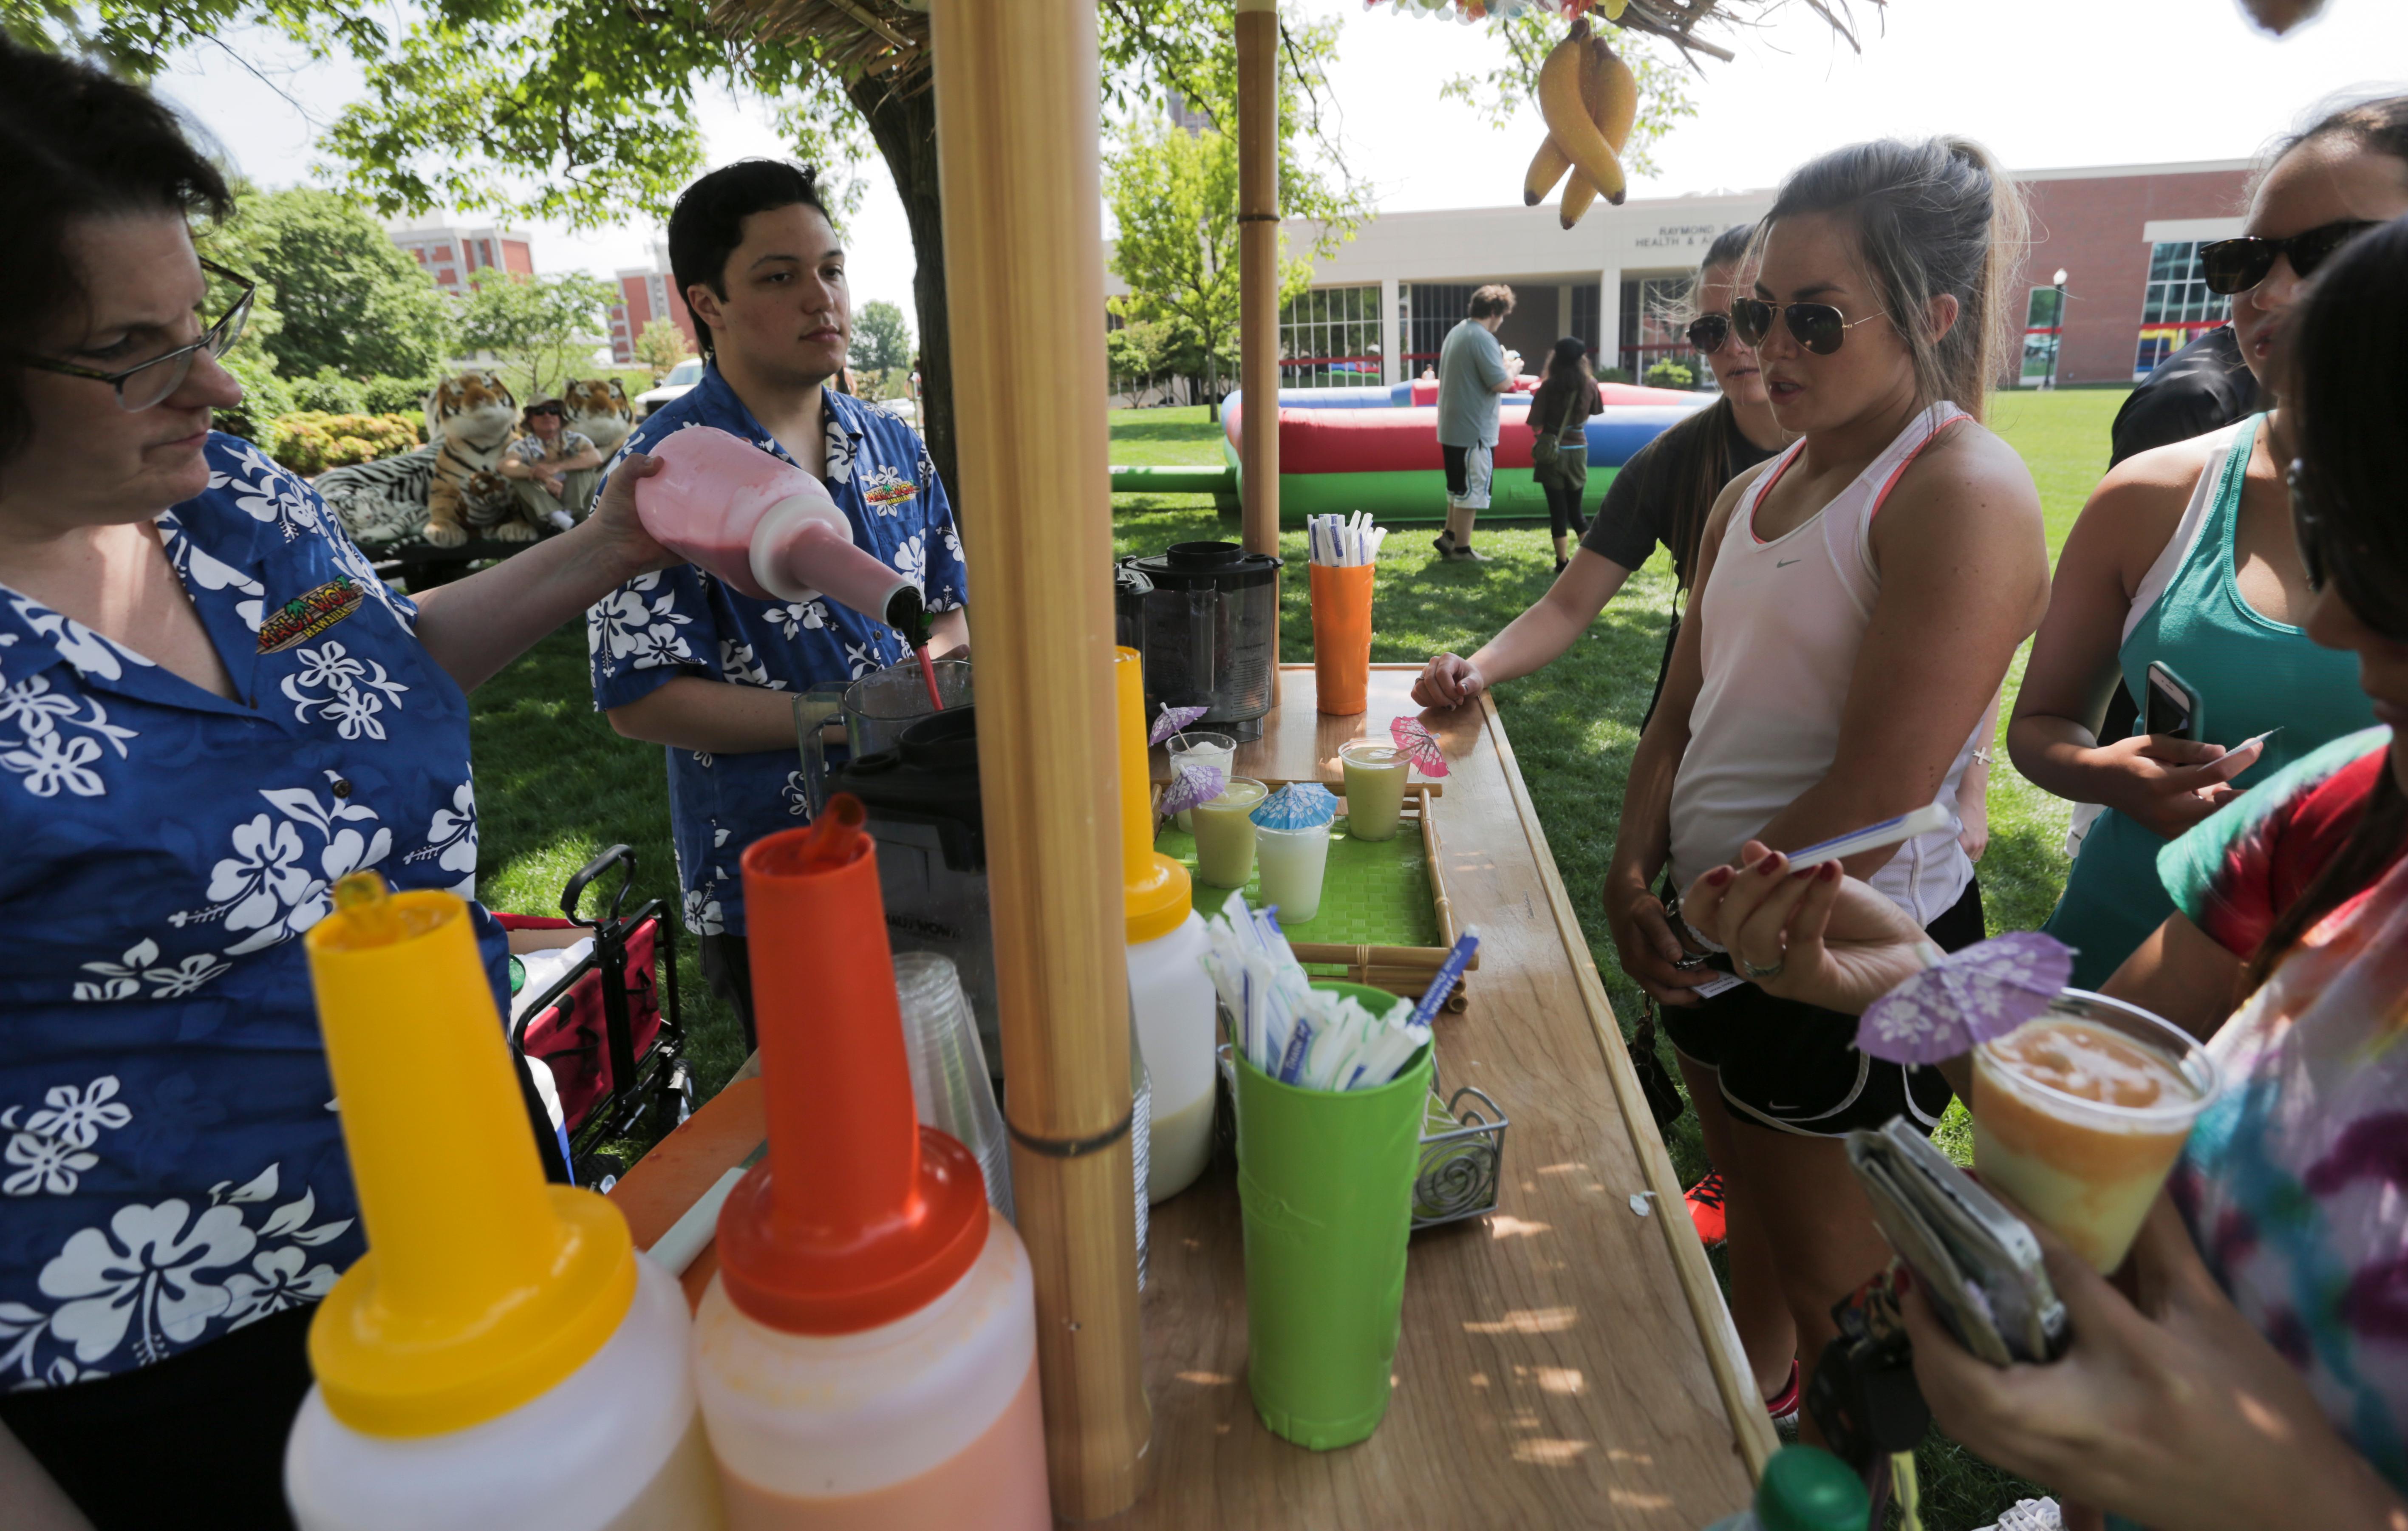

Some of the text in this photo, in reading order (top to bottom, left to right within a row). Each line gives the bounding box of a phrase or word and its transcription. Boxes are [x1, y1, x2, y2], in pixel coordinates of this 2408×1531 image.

[1659, 225, 1715, 235] RAYMOND
[1636, 237, 1679, 247] HEALTH
[1688, 237, 1694, 246] &
[886, 495, 911, 505] HAWAIIAN
[302, 606, 352, 638] HAWAIIAN
[258, 613, 314, 648] MAUI
